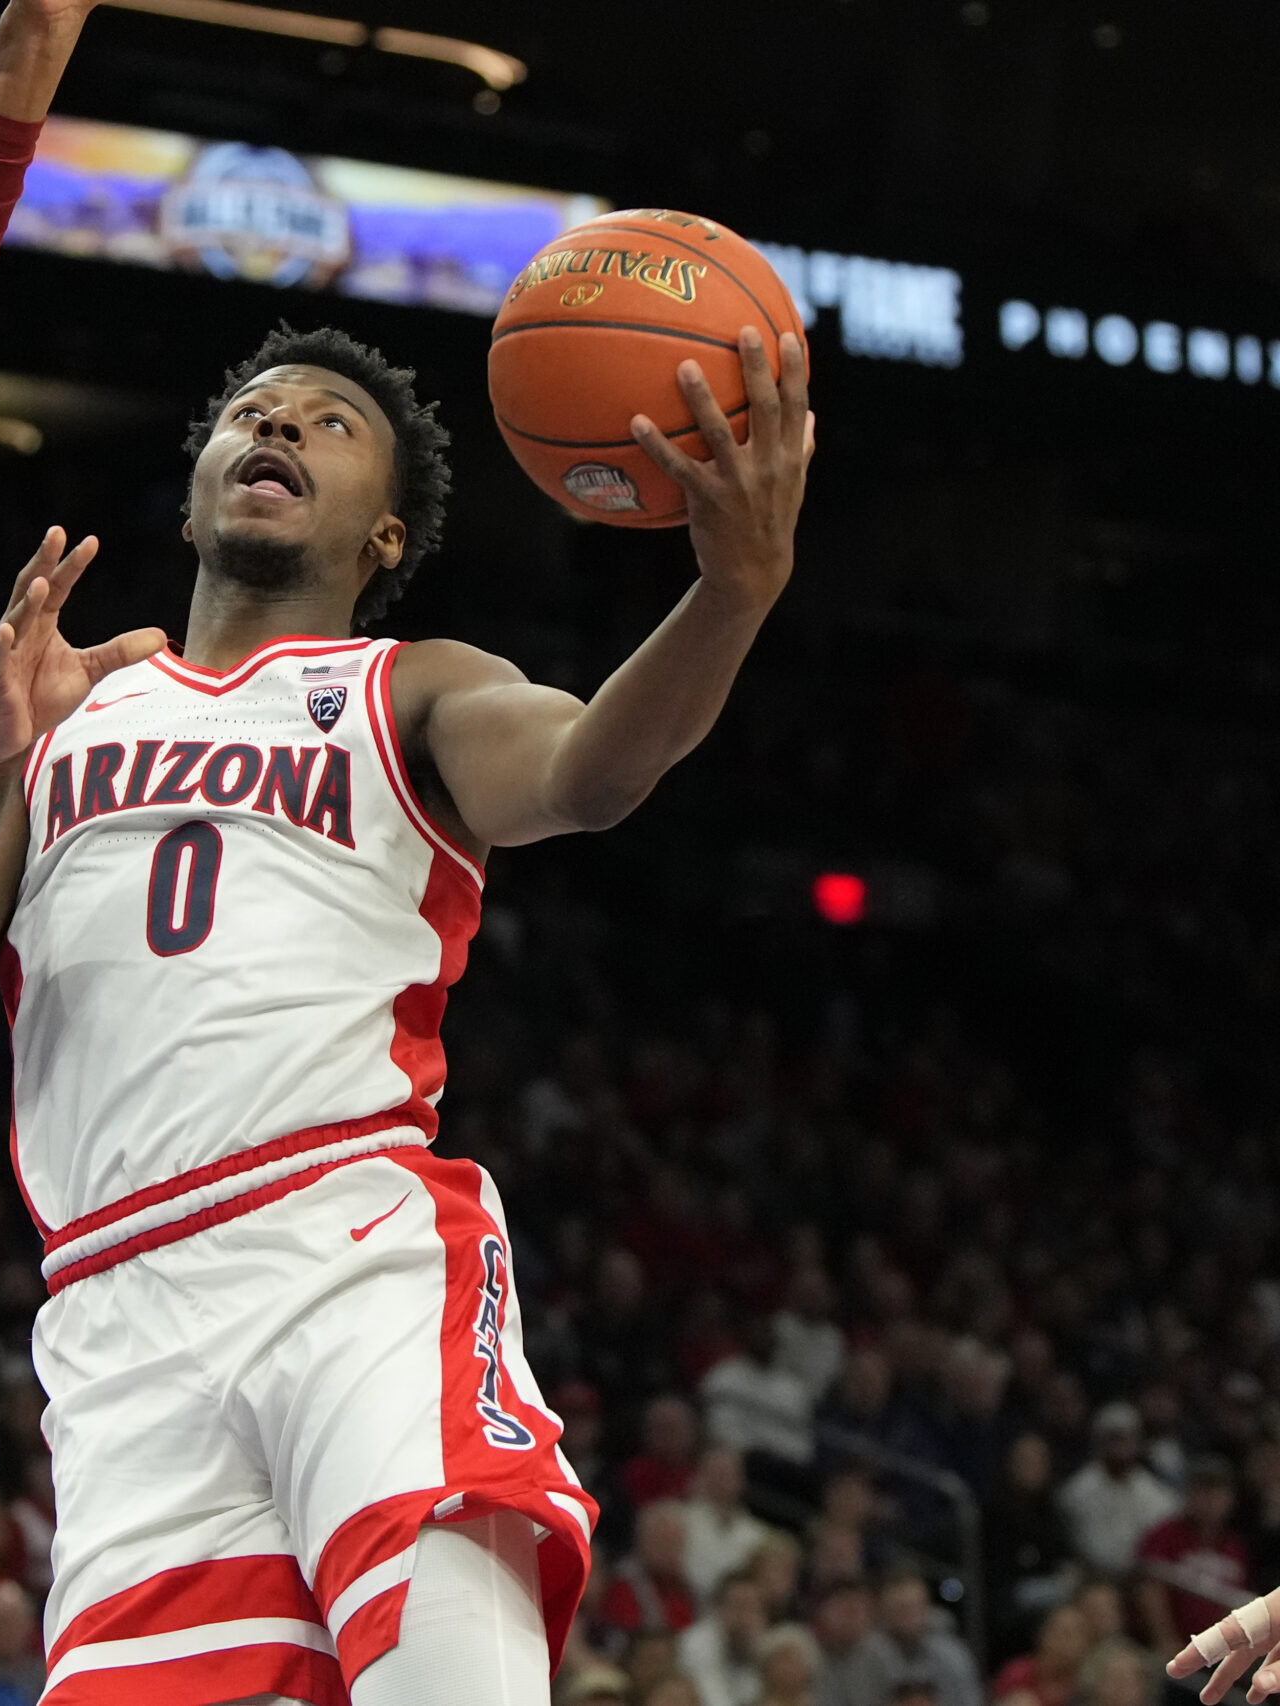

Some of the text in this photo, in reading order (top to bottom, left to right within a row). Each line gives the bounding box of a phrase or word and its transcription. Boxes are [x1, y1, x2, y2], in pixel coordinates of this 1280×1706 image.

[509, 248, 708, 303] SPALDING
[999, 299, 1280, 388] PHOENI
[309, 687, 345, 713] PAC
[317, 702, 337, 722] 12
[41, 740, 356, 854] ARIZONA
[146, 820, 223, 958] 0
[472, 1233, 536, 1451] CATS
